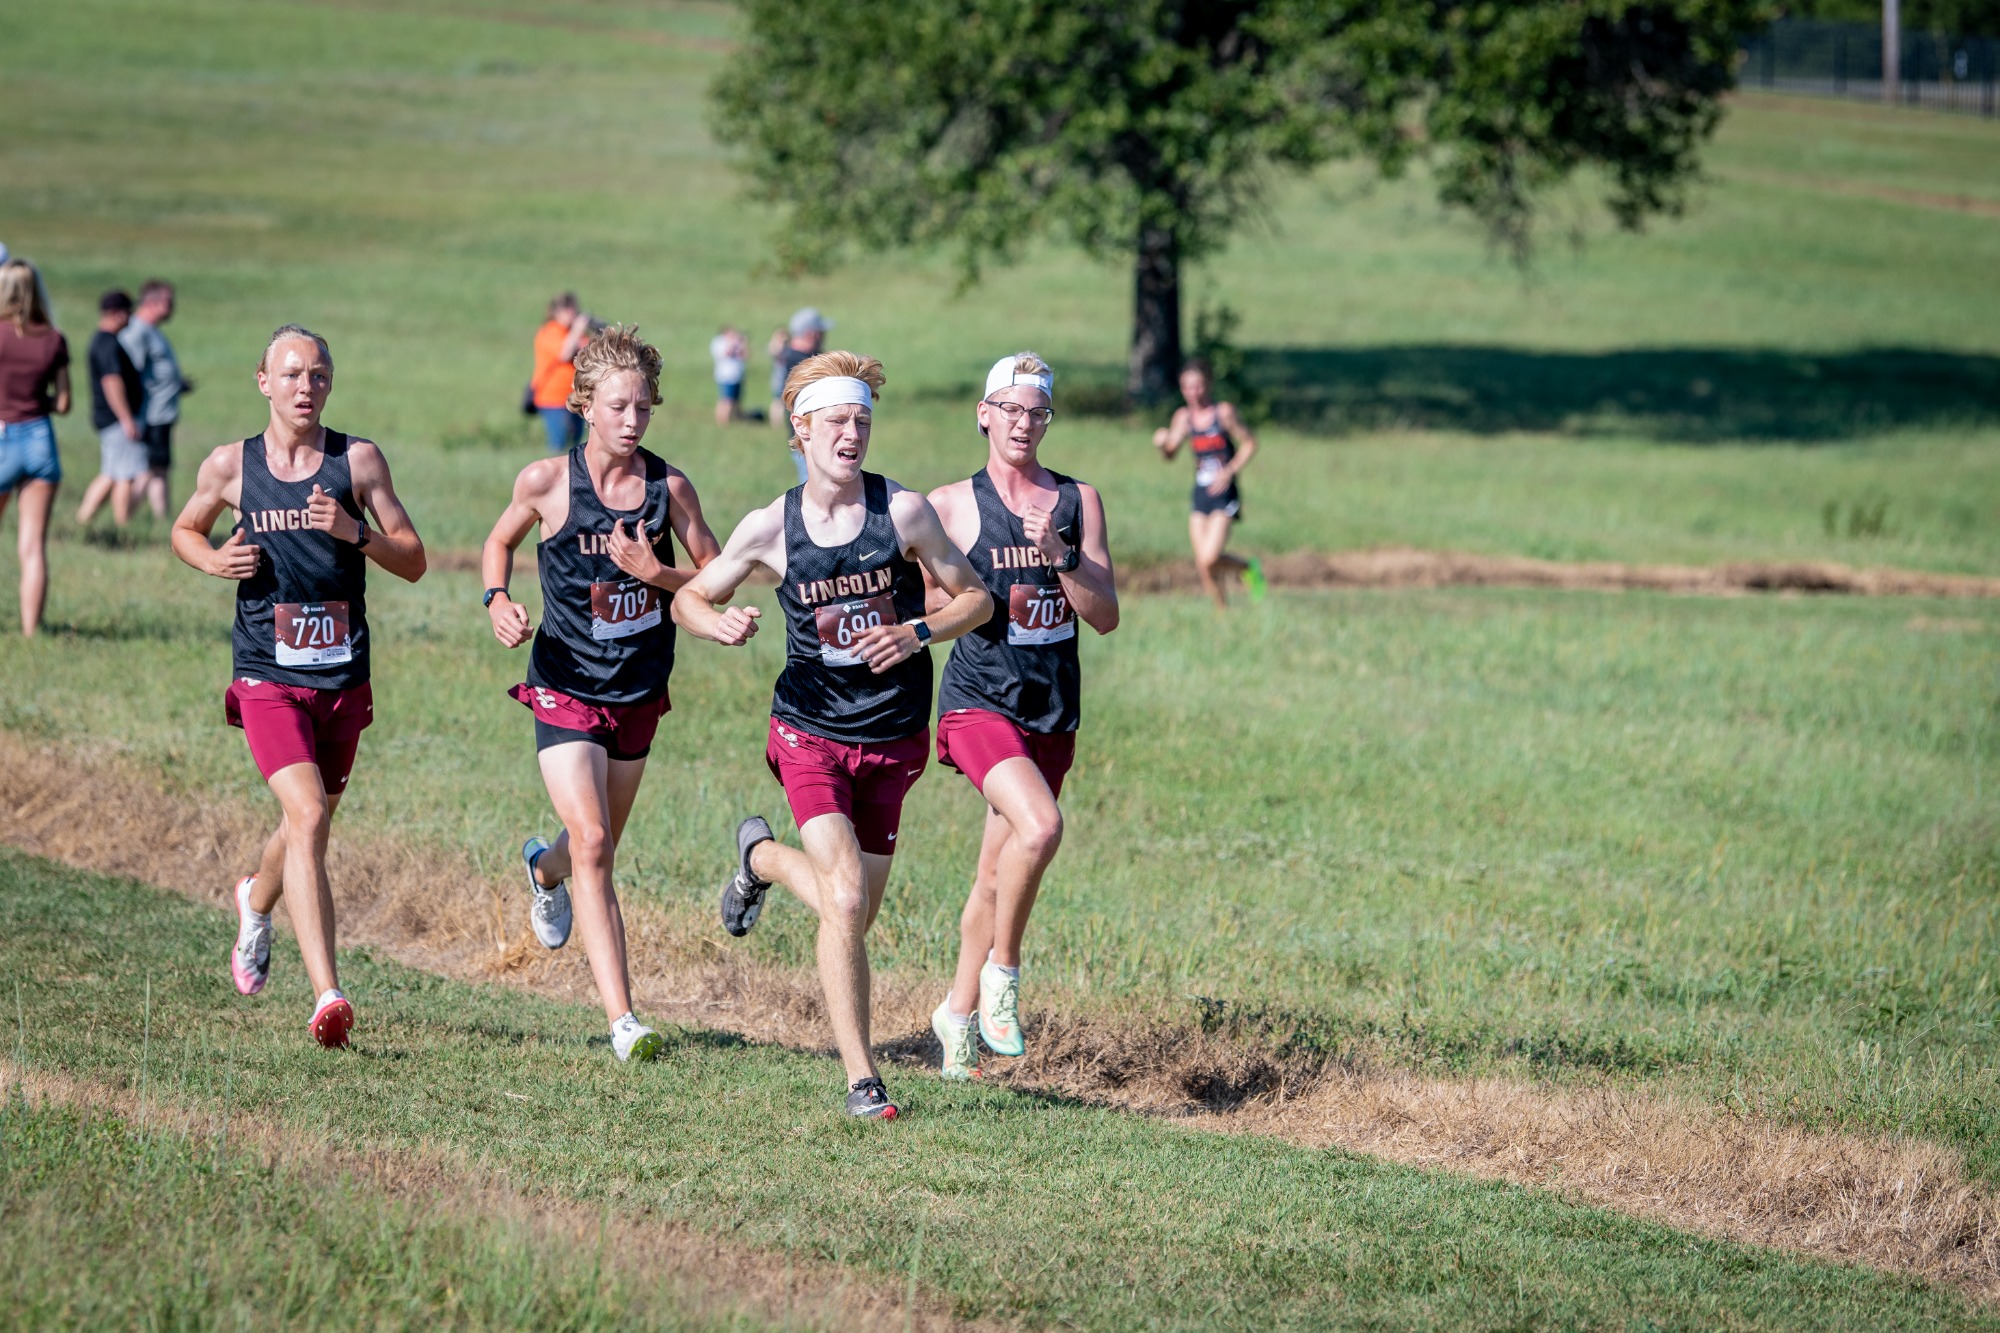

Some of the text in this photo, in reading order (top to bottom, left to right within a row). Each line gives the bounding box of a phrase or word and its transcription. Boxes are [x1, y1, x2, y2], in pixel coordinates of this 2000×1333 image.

[250, 508, 313, 533] LINCO
[798, 566, 892, 605] LINCOLN
[608, 587, 648, 621] 709
[1026, 597, 1066, 627] 703
[292, 615, 335, 646] 720
